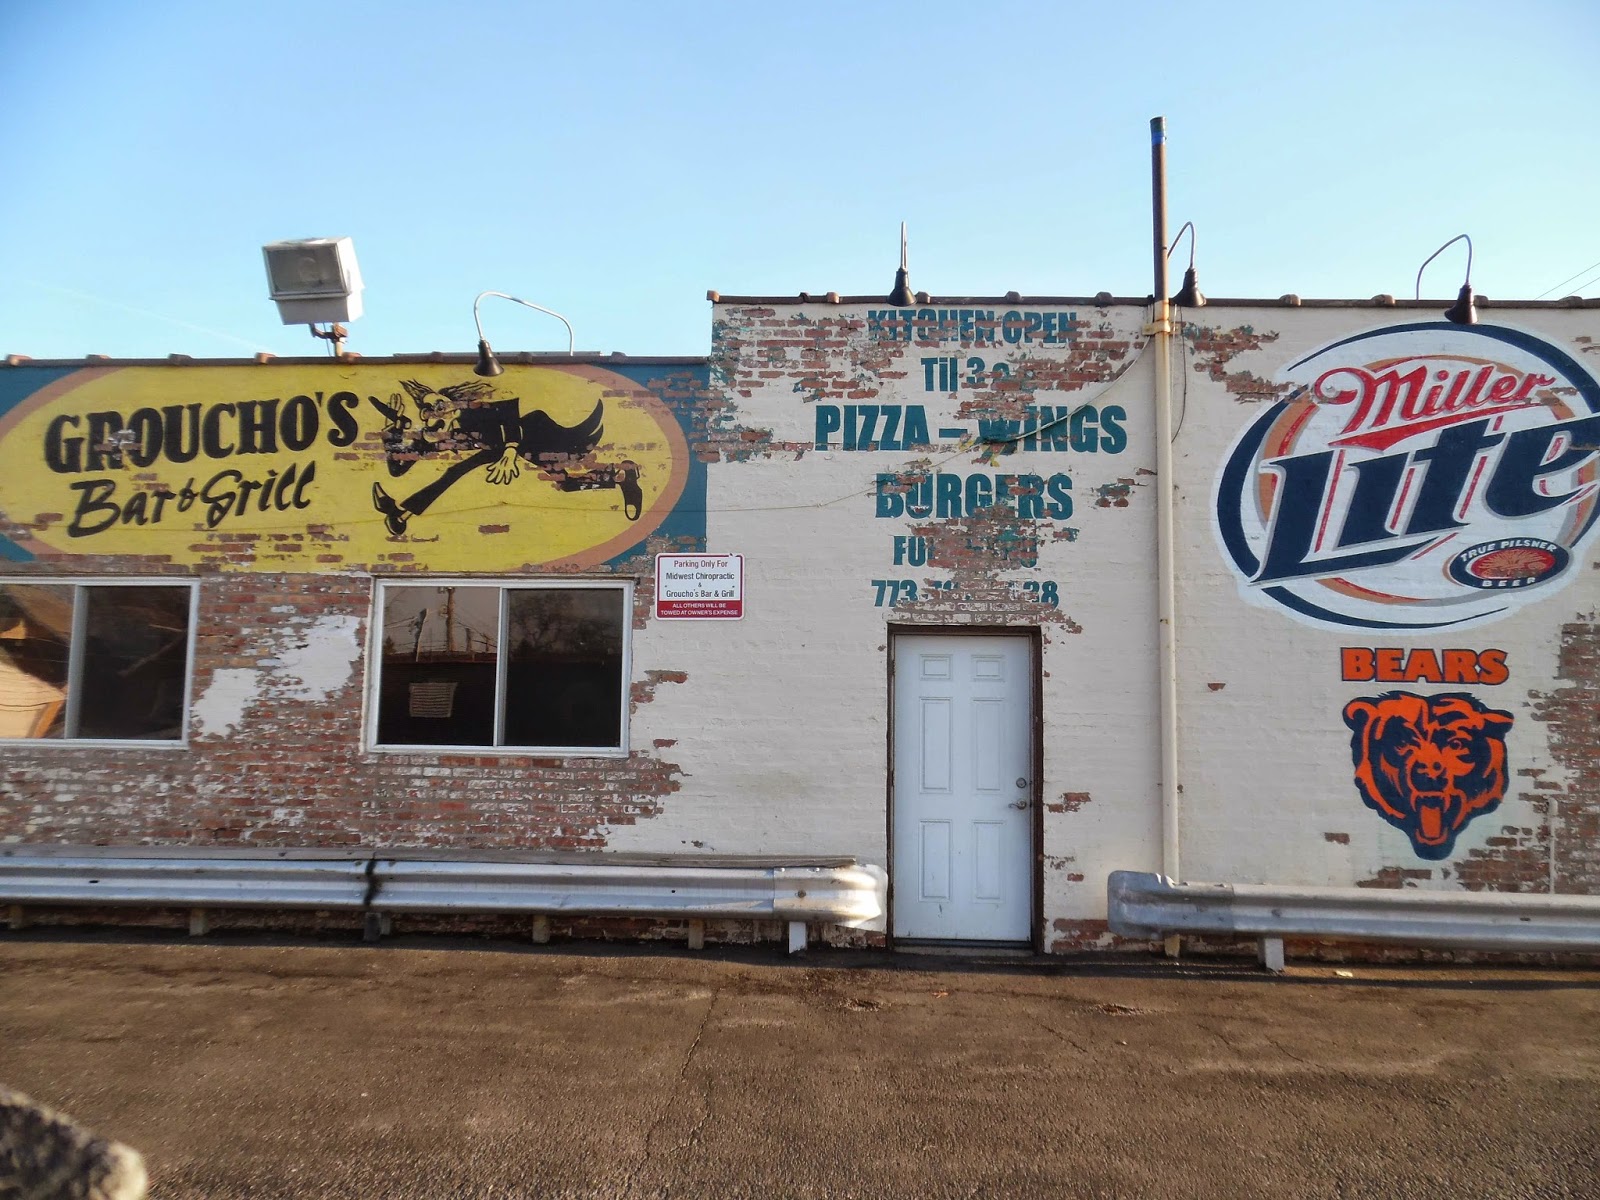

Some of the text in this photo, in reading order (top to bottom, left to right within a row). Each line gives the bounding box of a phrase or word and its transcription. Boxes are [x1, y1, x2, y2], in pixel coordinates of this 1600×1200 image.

[868, 309, 1077, 343] KITCHEN OPEN
[921, 357, 958, 392] Til
[1313, 365, 1556, 434] Miller
[44, 391, 359, 473] GROUCHO'S
[815, 405, 930, 451] PIZZA
[977, 405, 1128, 454] WINGS
[67, 479, 177, 538] Bar
[200, 460, 315, 528] Grill
[875, 473, 1074, 520] BURGERS
[1248, 412, 1600, 586] Lite
[674, 560, 699, 569] Parking
[701, 560, 715, 569] Only
[1460, 540, 1557, 562] TRUE PILSNER
[666, 589, 699, 597] Groucho's
[696, 572, 735, 581] Chiropractic
[1482, 577, 1536, 587] BEER
[1340, 647, 1510, 685] BEARS
